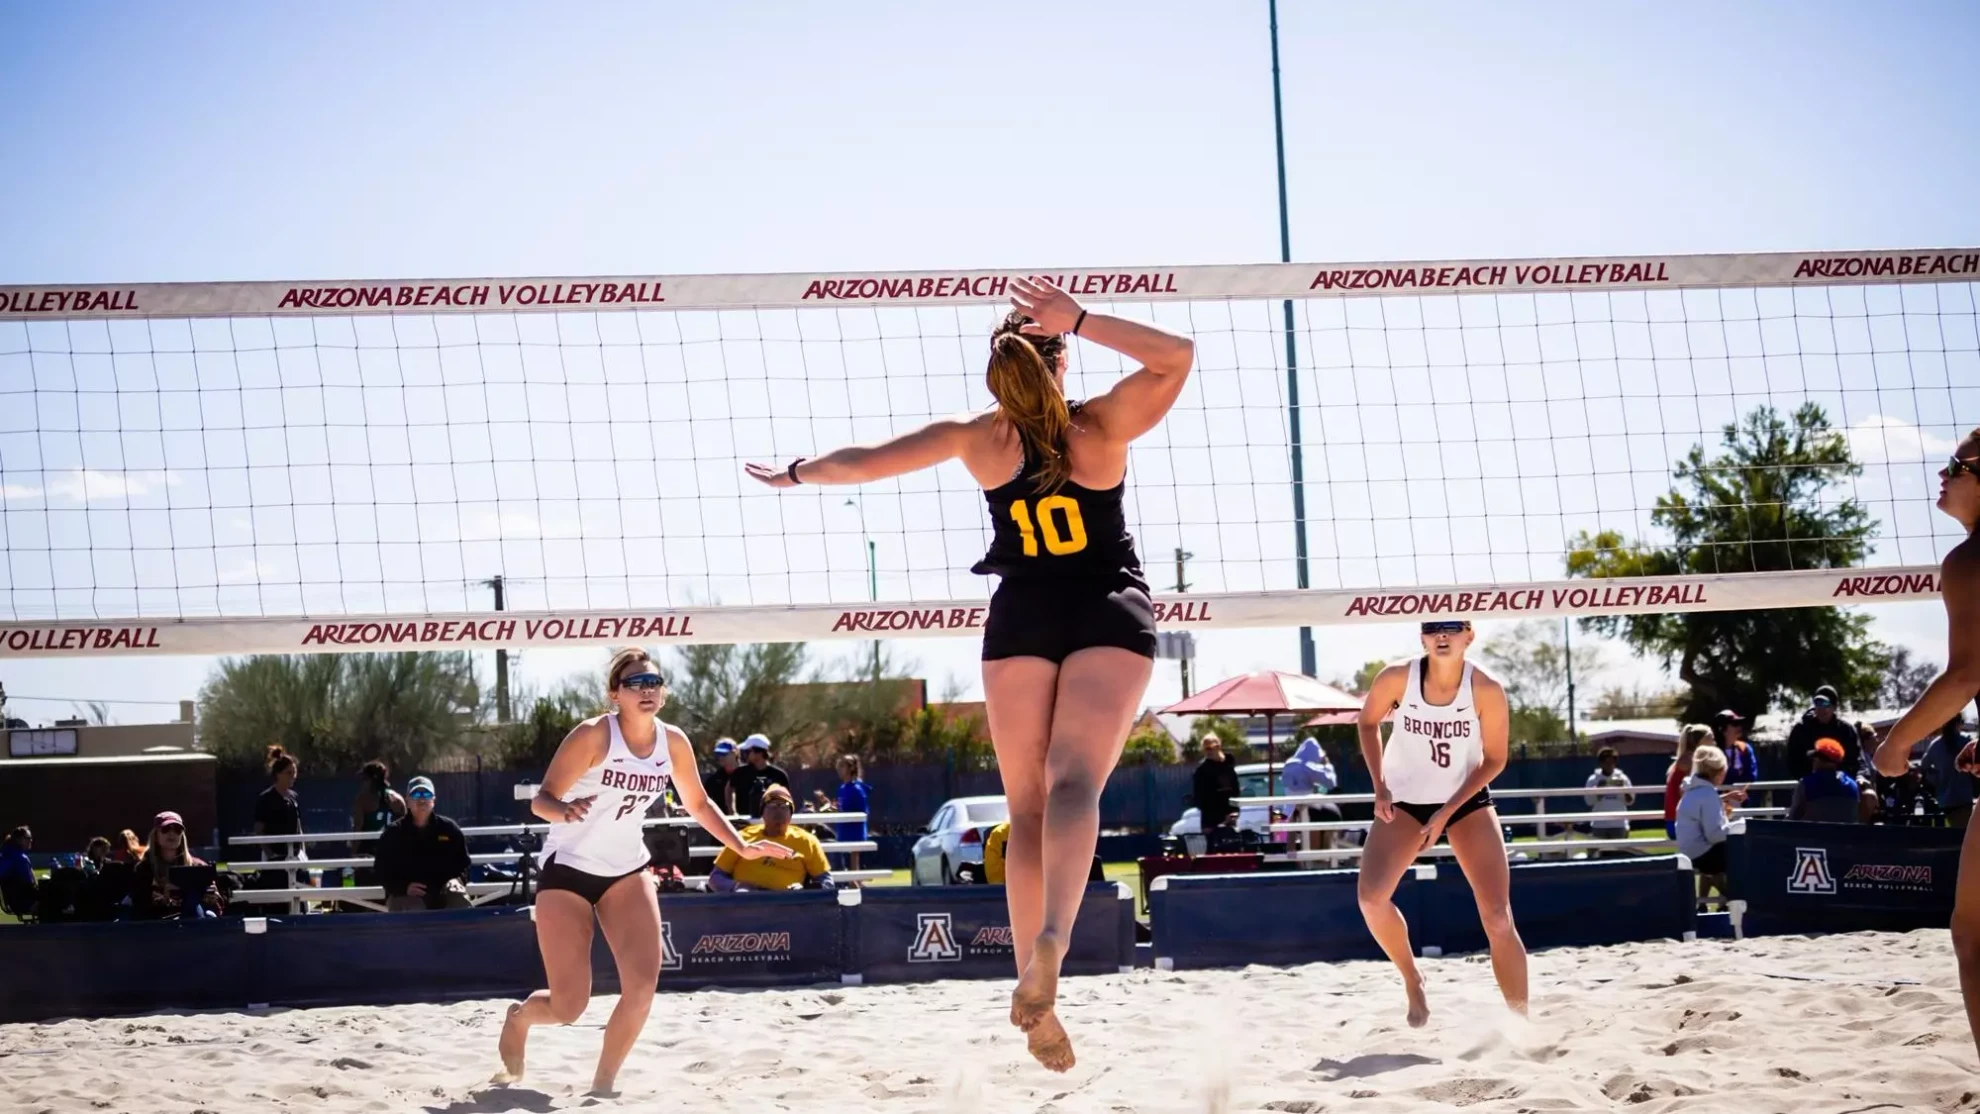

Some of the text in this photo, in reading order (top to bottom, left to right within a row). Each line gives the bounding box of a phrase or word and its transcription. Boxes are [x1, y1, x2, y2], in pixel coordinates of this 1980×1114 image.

[1515, 262, 1670, 285] VOLLEYBALL
[498, 282, 665, 305] VOLLEYBALL
[1010, 495, 1087, 557] 10
[1552, 583, 1707, 608] VOLLEYBALL
[1832, 574, 1934, 597] ARIZONA
[525, 616, 693, 640] VOLLEYBALL
[947, 608, 988, 629] BE
[1403, 715, 1470, 739] BRONCOS
[1429, 739, 1451, 768] 16
[1844, 864, 1932, 884] ARIZONA
[1878, 884, 1933, 892] VOLLEYBALL
[692, 932, 790, 953] ARIZONA
[971, 926, 1013, 946] ARI
[729, 954, 791, 962] VOLLEYBALL
